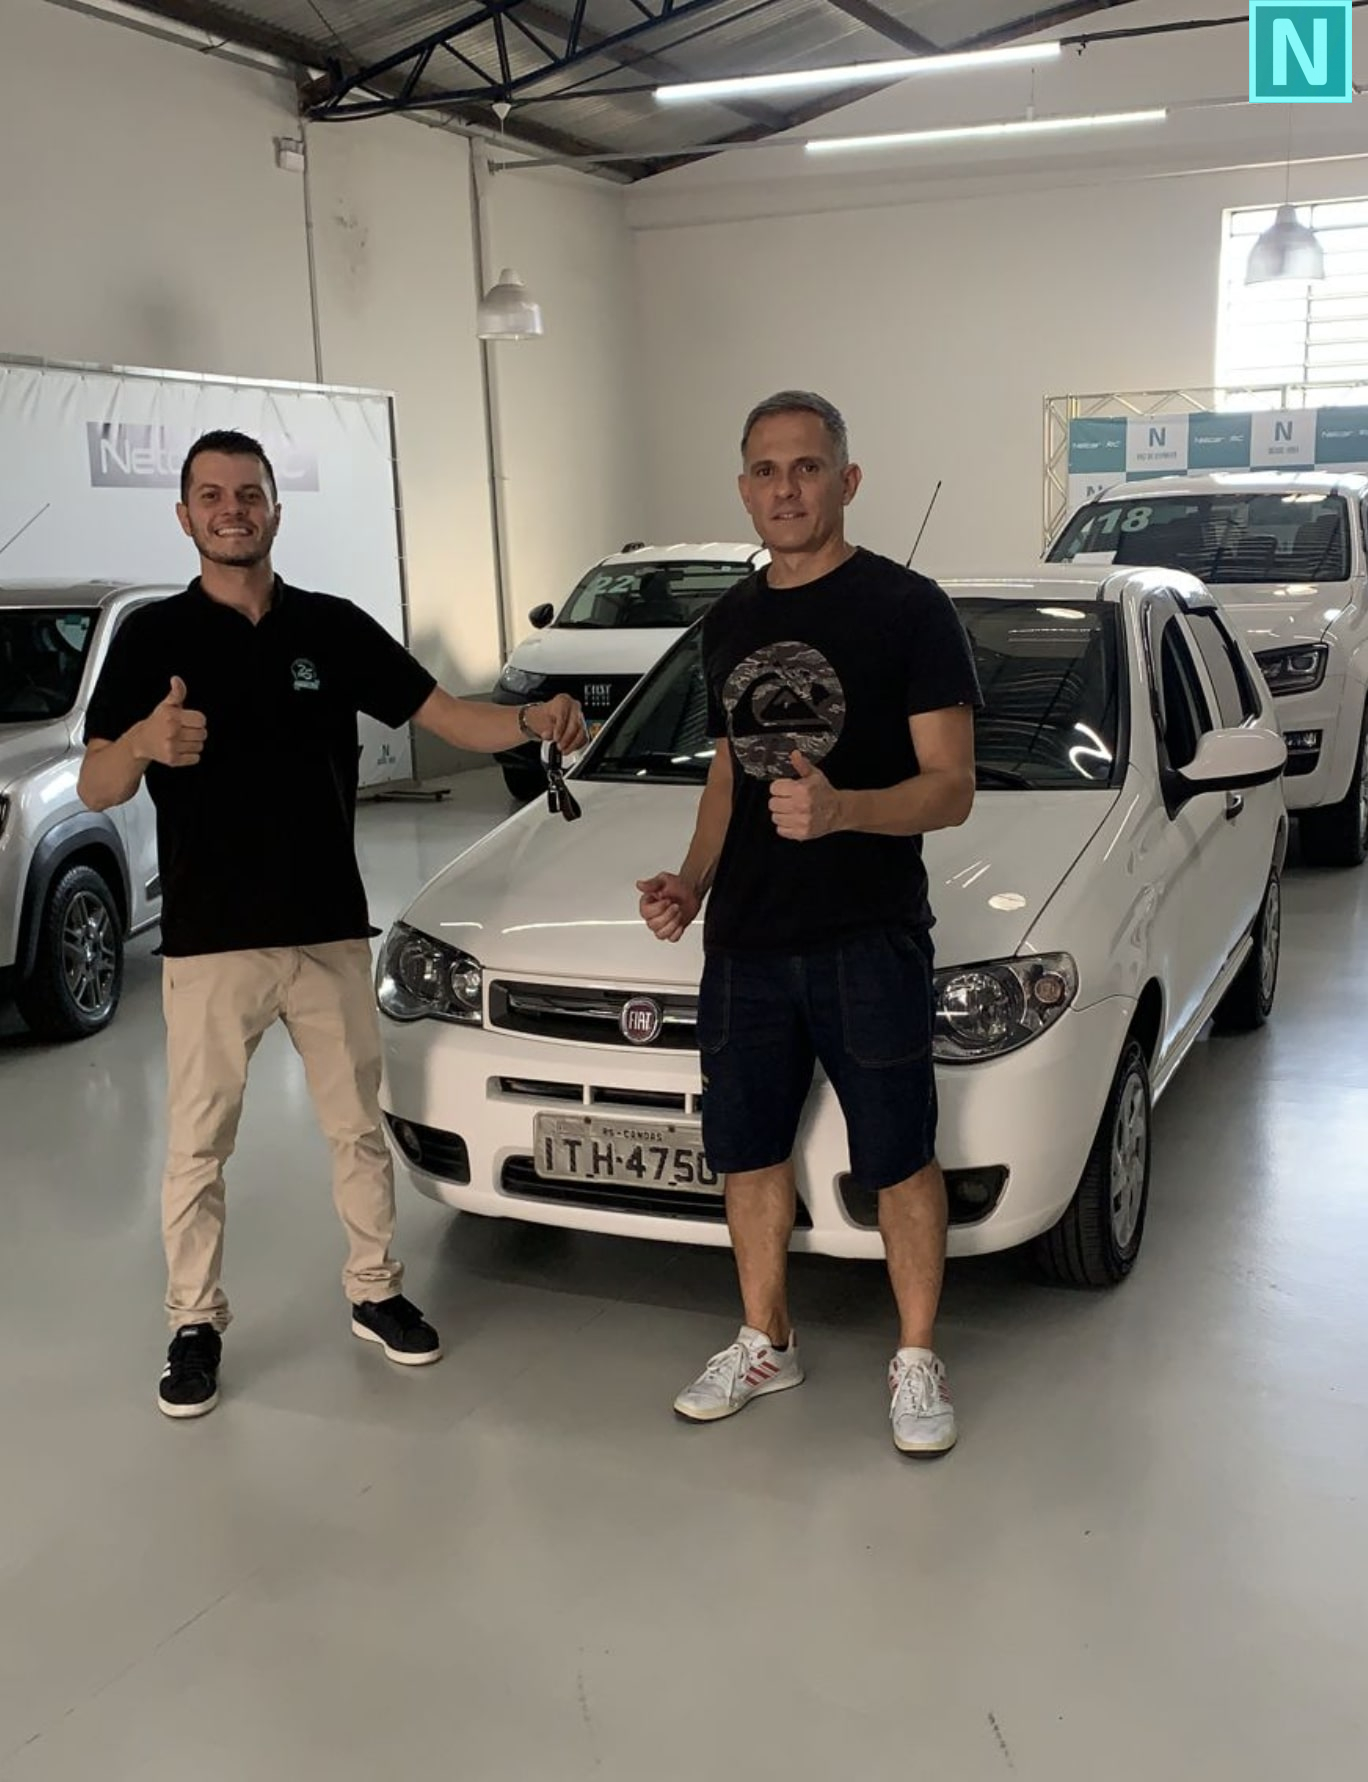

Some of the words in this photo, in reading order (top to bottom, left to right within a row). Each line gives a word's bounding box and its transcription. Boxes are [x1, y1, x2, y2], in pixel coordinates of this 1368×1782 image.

[1148, 426, 1166, 447] N
[1274, 421, 1293, 441] N
[1097, 507, 1153, 534] 18
[597, 575, 630, 595] 22
[629, 1010, 652, 1031] FIAT
